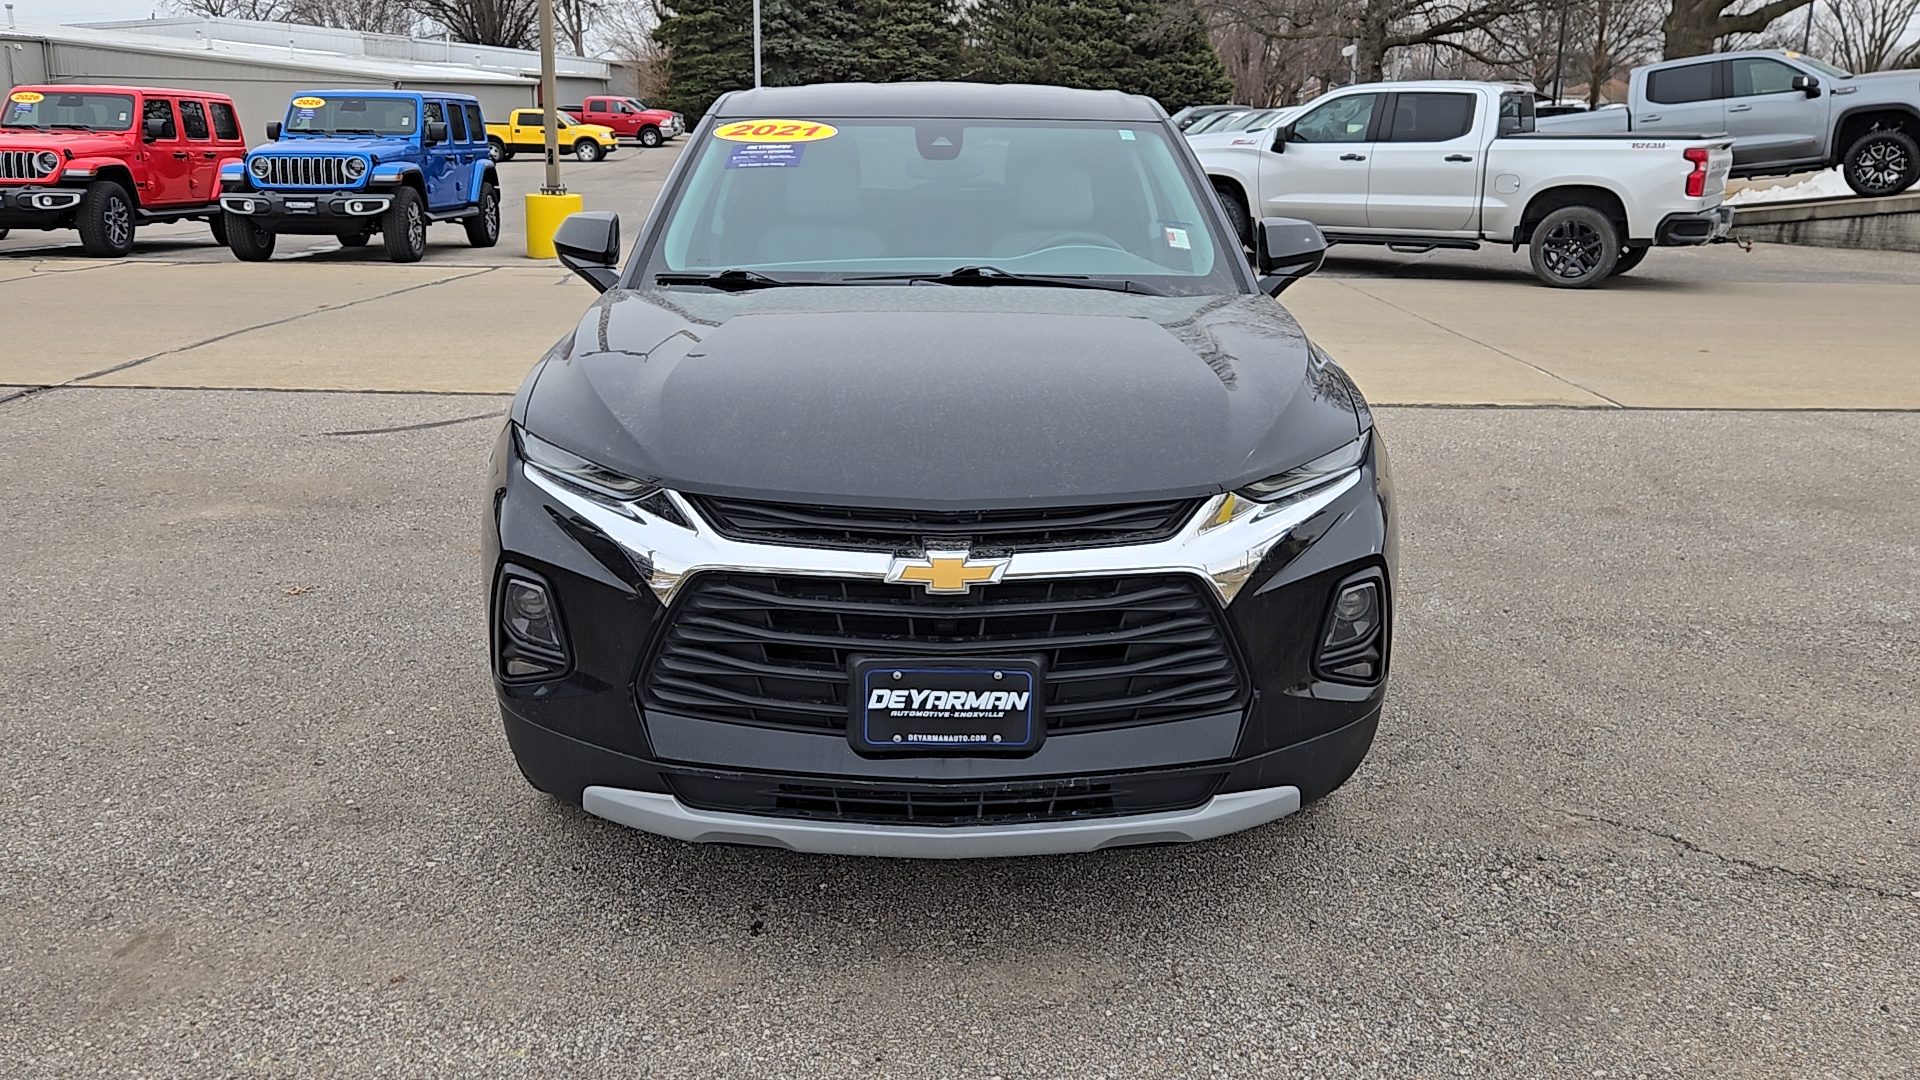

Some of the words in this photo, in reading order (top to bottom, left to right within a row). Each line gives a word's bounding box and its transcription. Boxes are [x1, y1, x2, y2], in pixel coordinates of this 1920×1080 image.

[725, 124, 822, 137] 2021
[868, 688, 1030, 711] DEYARMAN
[907, 734, 987, 742] DEYARMANAUTO.COM
